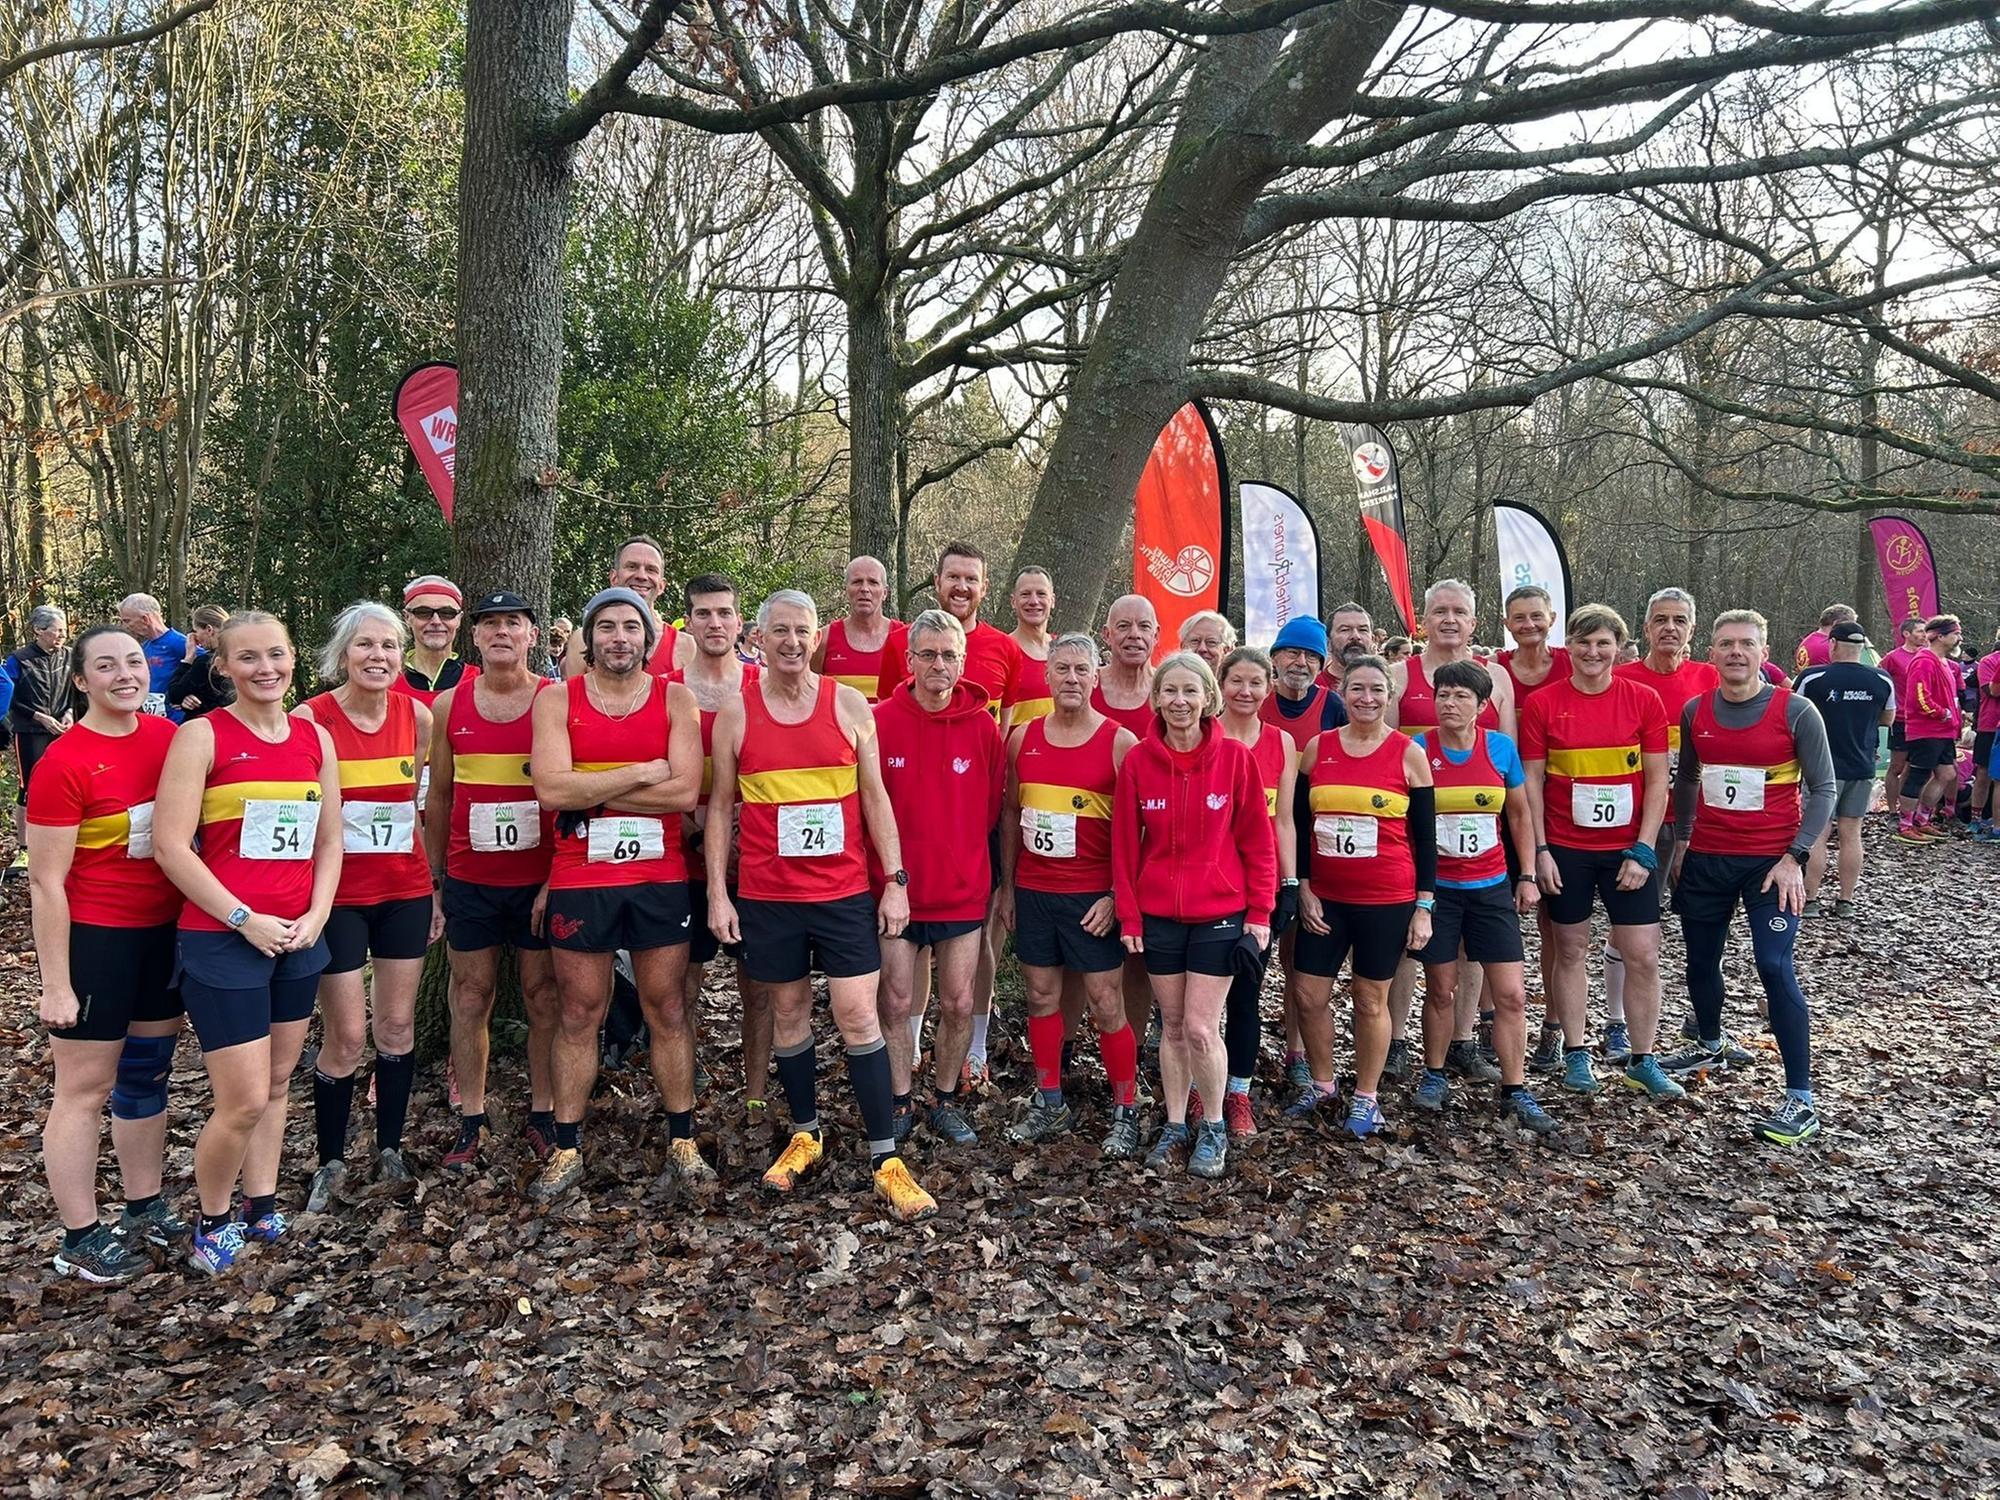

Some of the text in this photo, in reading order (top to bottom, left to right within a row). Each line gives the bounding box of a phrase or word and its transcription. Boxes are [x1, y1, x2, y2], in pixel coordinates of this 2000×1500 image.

[888, 757, 905, 768] P.M
[1725, 785, 1737, 805] 9
[1592, 803, 1615, 822] 50
[271, 826, 299, 853] 54
[370, 824, 393, 847] 17
[495, 824, 518, 846] 10
[801, 827, 825, 850] 24
[1034, 831, 1054, 852] 65
[1335, 834, 1355, 855] 16
[1459, 833, 1479, 853] 13
[613, 840, 641, 860] 69
